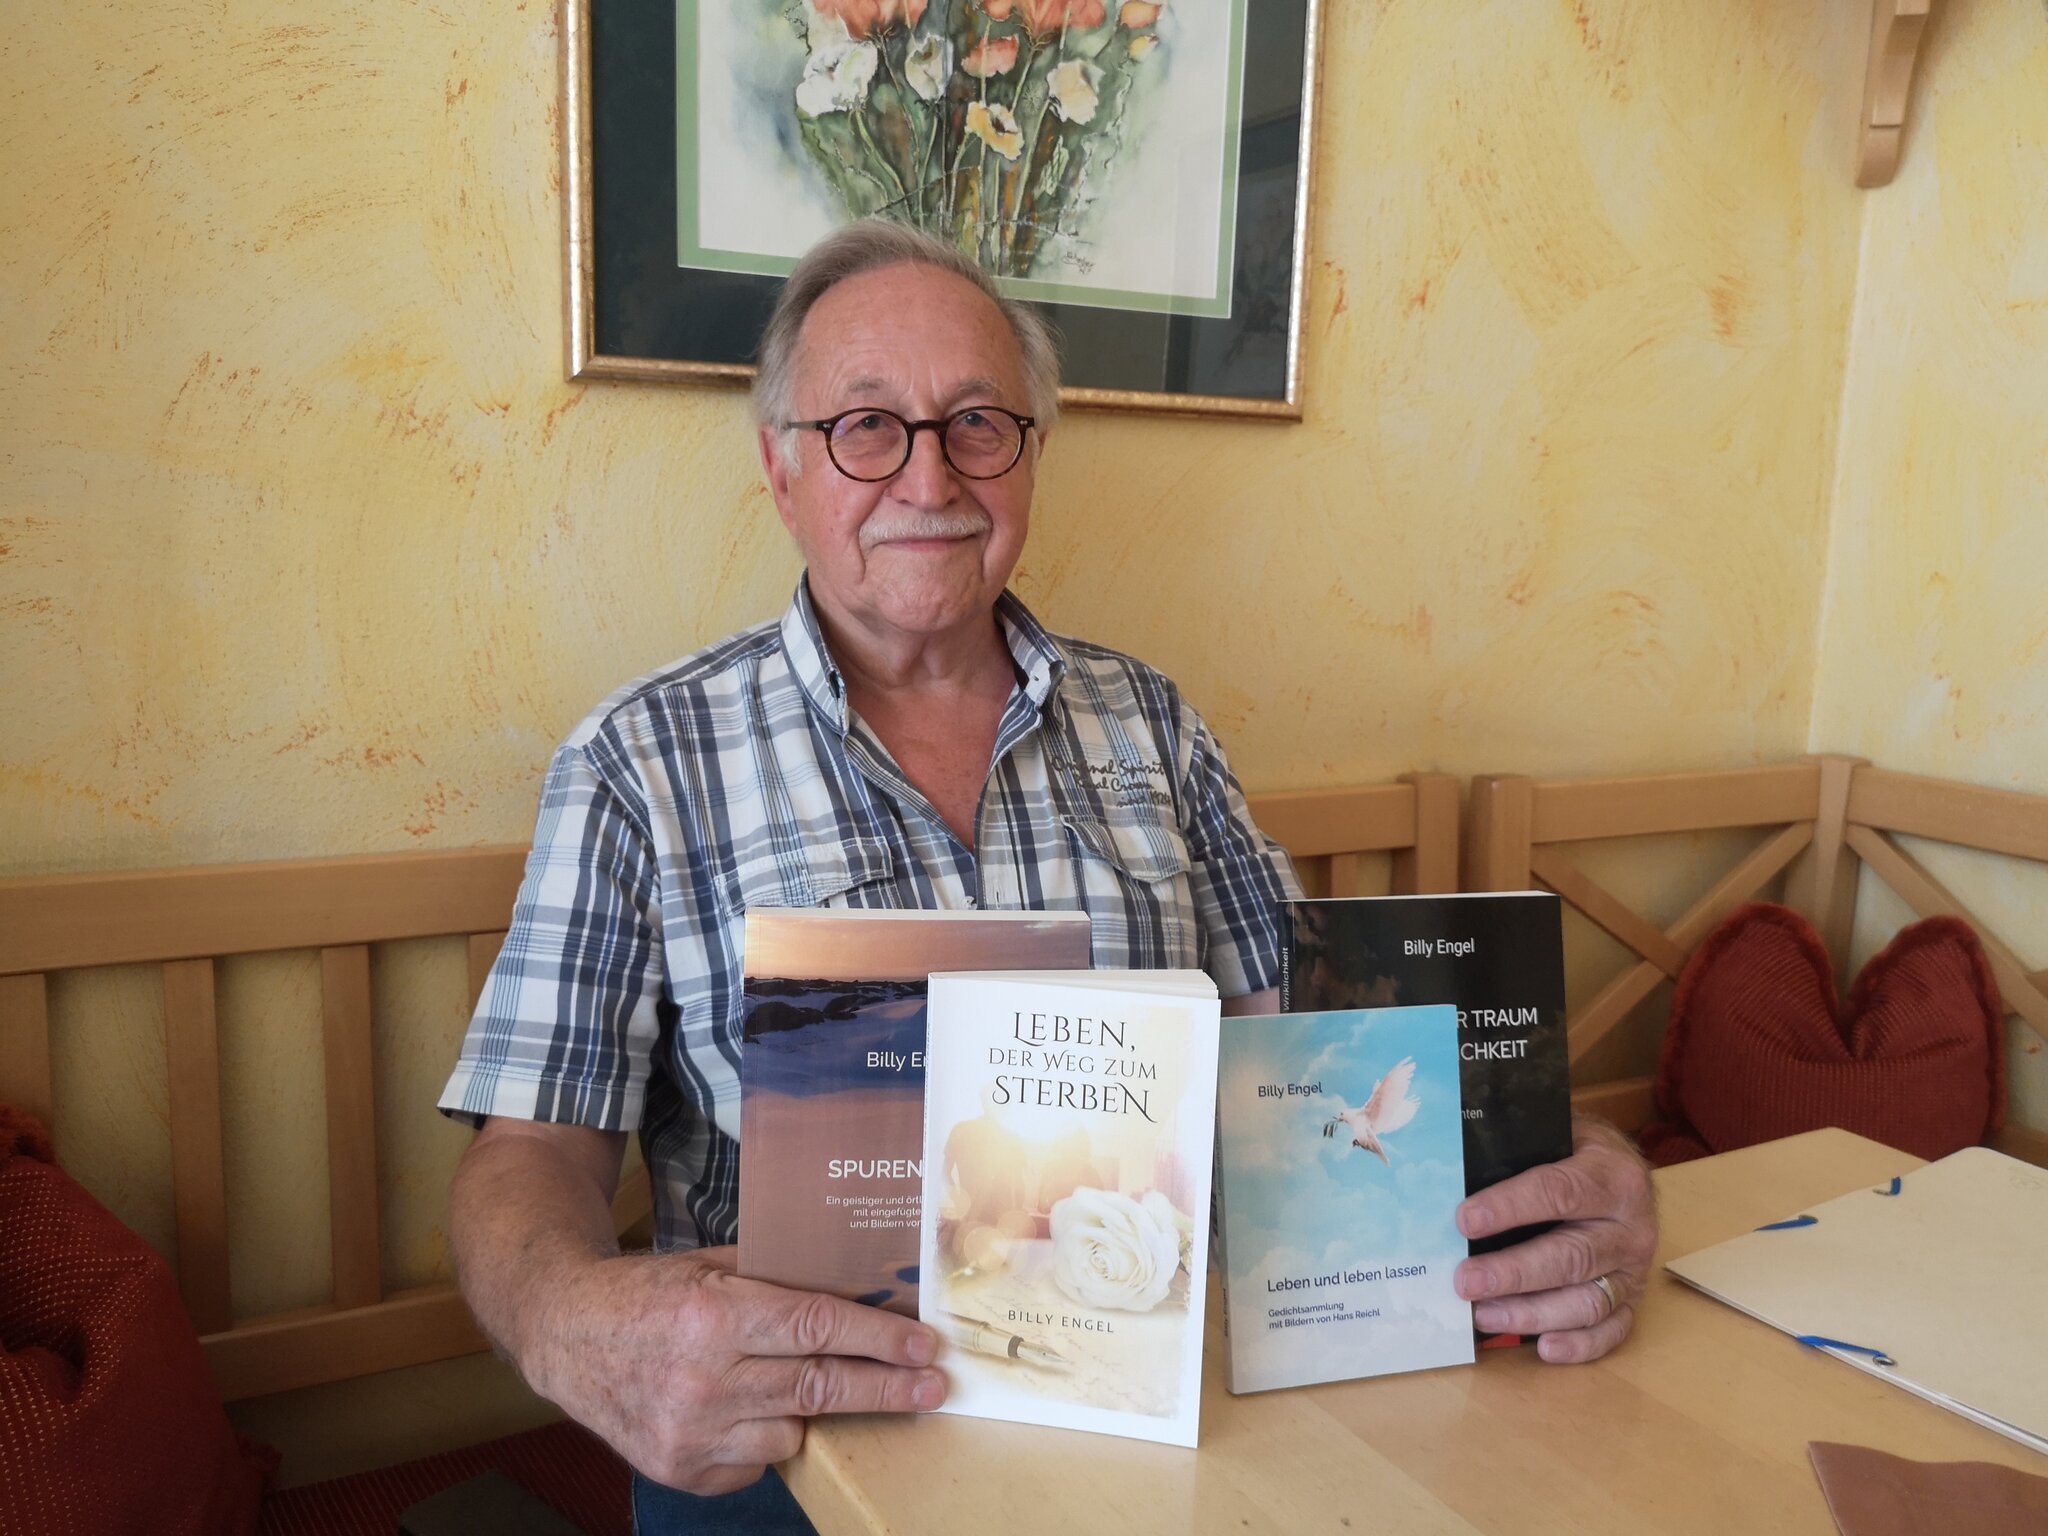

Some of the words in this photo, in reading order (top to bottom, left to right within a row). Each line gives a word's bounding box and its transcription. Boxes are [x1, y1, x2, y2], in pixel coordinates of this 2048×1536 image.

[1404, 939, 1434, 959] Billy
[1437, 937, 1476, 958] Engel
[1456, 1010, 1468, 1029] R
[1470, 1006, 1538, 1028] TRAUM
[1013, 1011, 1136, 1052] LEBEN,
[1460, 1039, 1528, 1061] CHKEIT
[867, 1051, 907, 1072] Billy
[988, 1047, 1034, 1068] DER
[1103, 1057, 1158, 1080] ZUM
[991, 1074, 1158, 1124] STERBEN
[1258, 1083, 1285, 1099] Billy
[1287, 1081, 1323, 1098] Engel
[827, 1159, 924, 1179] SPUREN
[826, 1195, 841, 1205] Ein
[843, 1195, 883, 1207] geistiger
[885, 1195, 904, 1205] und
[853, 1207, 868, 1217] mit
[870, 1206, 921, 1218] eingefügte
[850, 1219, 868, 1229] und
[871, 1218, 904, 1229] Bildern
[1266, 1276, 1311, 1292] Leben
[1314, 1271, 1341, 1288] und
[1343, 1268, 1382, 1284] leben
[1385, 1264, 1427, 1280] lassen
[1267, 1301, 1345, 1318] Gedichtsammlung
[1268, 1321, 1283, 1330] mit
[1284, 1316, 1315, 1329] Bildern
[1316, 1315, 1332, 1324] von
[1332, 1312, 1354, 1323] Hans
[1355, 1308, 1381, 1320] Reichl
[1008, 1309, 1053, 1325] BILLY
[1061, 1316, 1114, 1333] ENGEL
